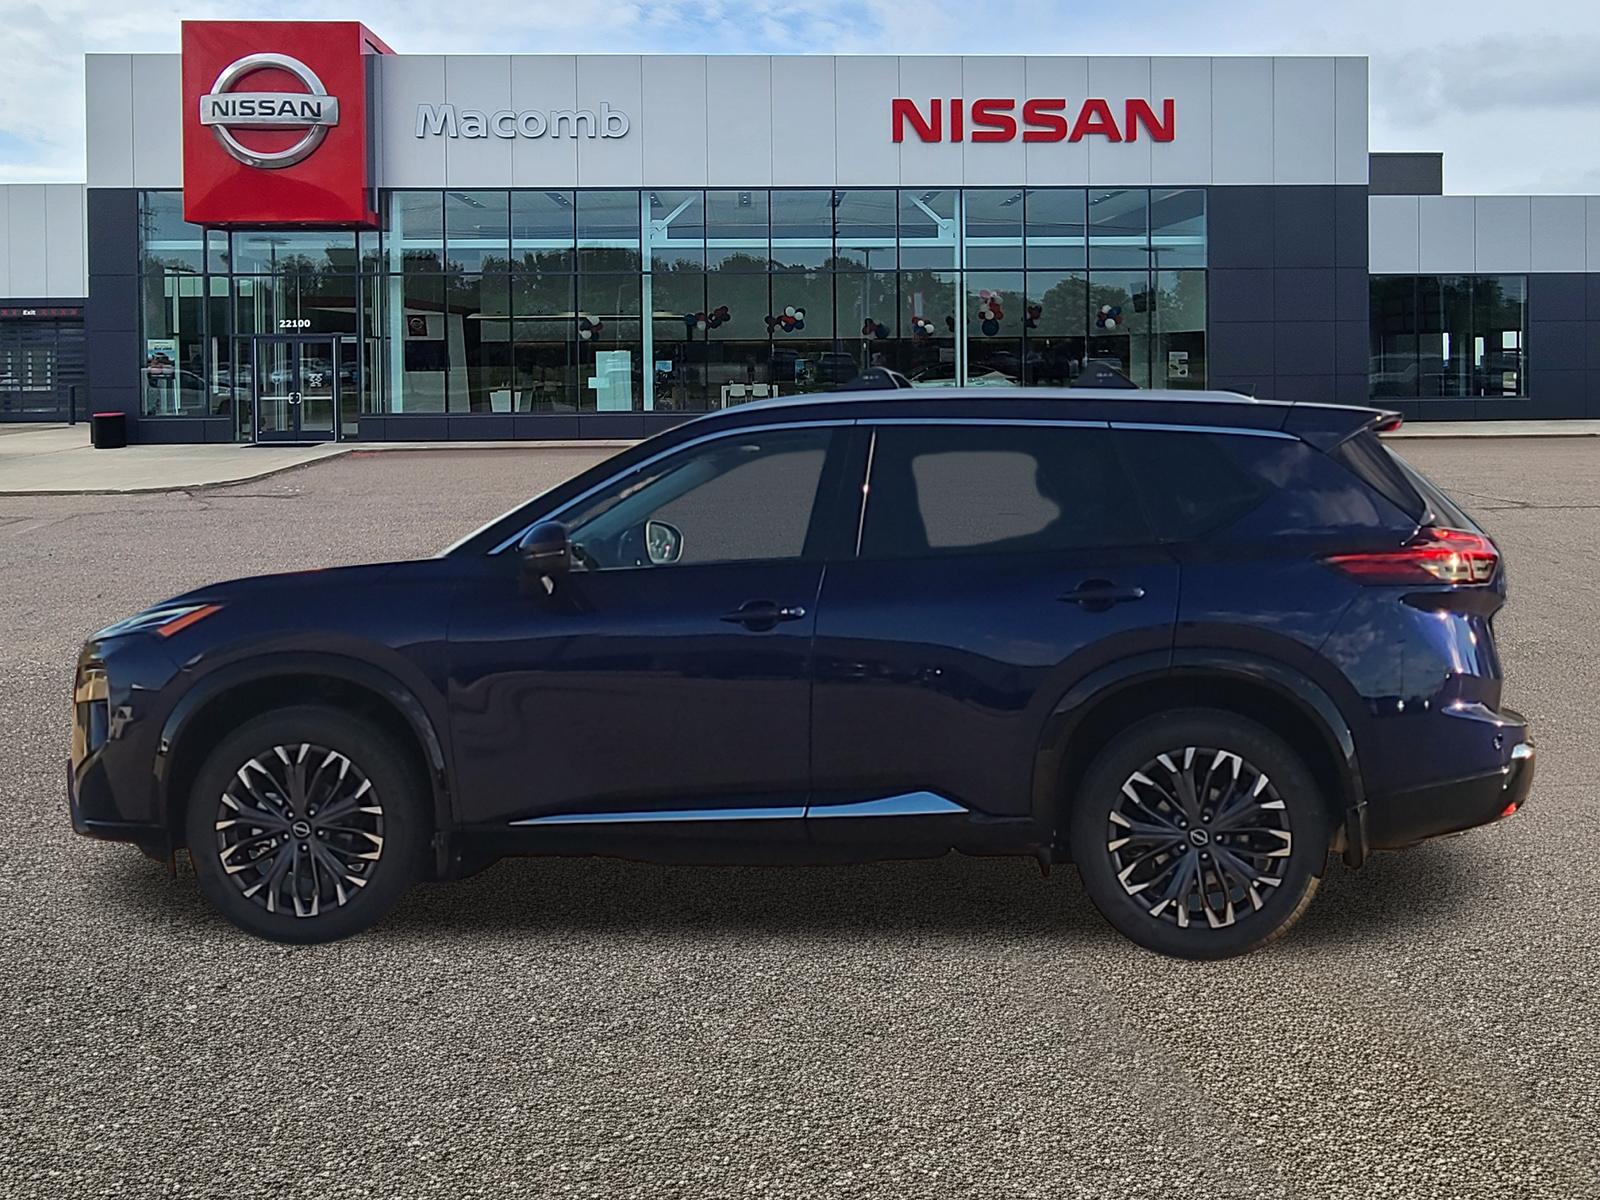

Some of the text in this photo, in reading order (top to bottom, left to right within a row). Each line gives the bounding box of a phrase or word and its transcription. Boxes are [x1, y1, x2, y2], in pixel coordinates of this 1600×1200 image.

[212, 100, 322, 117] NISSAN
[415, 101, 630, 138] Macomb
[892, 98, 1175, 142] NISSAN
[279, 319, 311, 328] 22100
